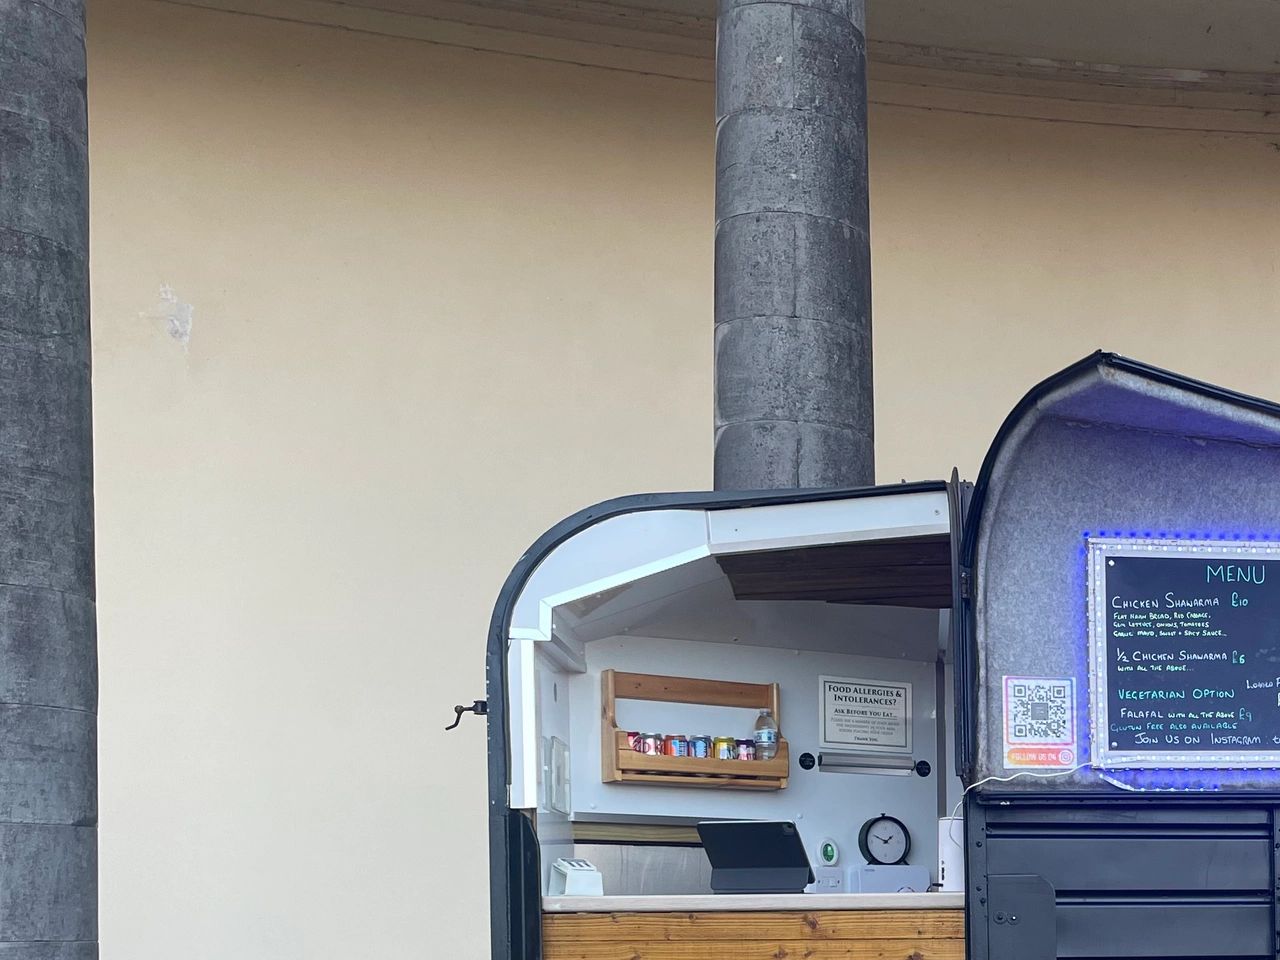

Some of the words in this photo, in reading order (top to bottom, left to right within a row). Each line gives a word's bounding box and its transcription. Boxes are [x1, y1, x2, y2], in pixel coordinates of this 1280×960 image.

[1207, 565, 1265, 584] MENU
[1112, 596, 1159, 609] CHICKEN
[1132, 650, 1174, 661] CHICKEN
[828, 684, 851, 693] FOOD
[853, 686, 894, 697] ALLERGIES
[1118, 689, 1185, 700] VEGETARIAN
[1192, 688, 1235, 700] OPTION
[834, 694, 897, 706] INTOLERANCES?
[1120, 708, 1163, 719] FALAFAL
[1135, 732, 1158, 744] JOIN
[1184, 735, 1200, 744] ON
